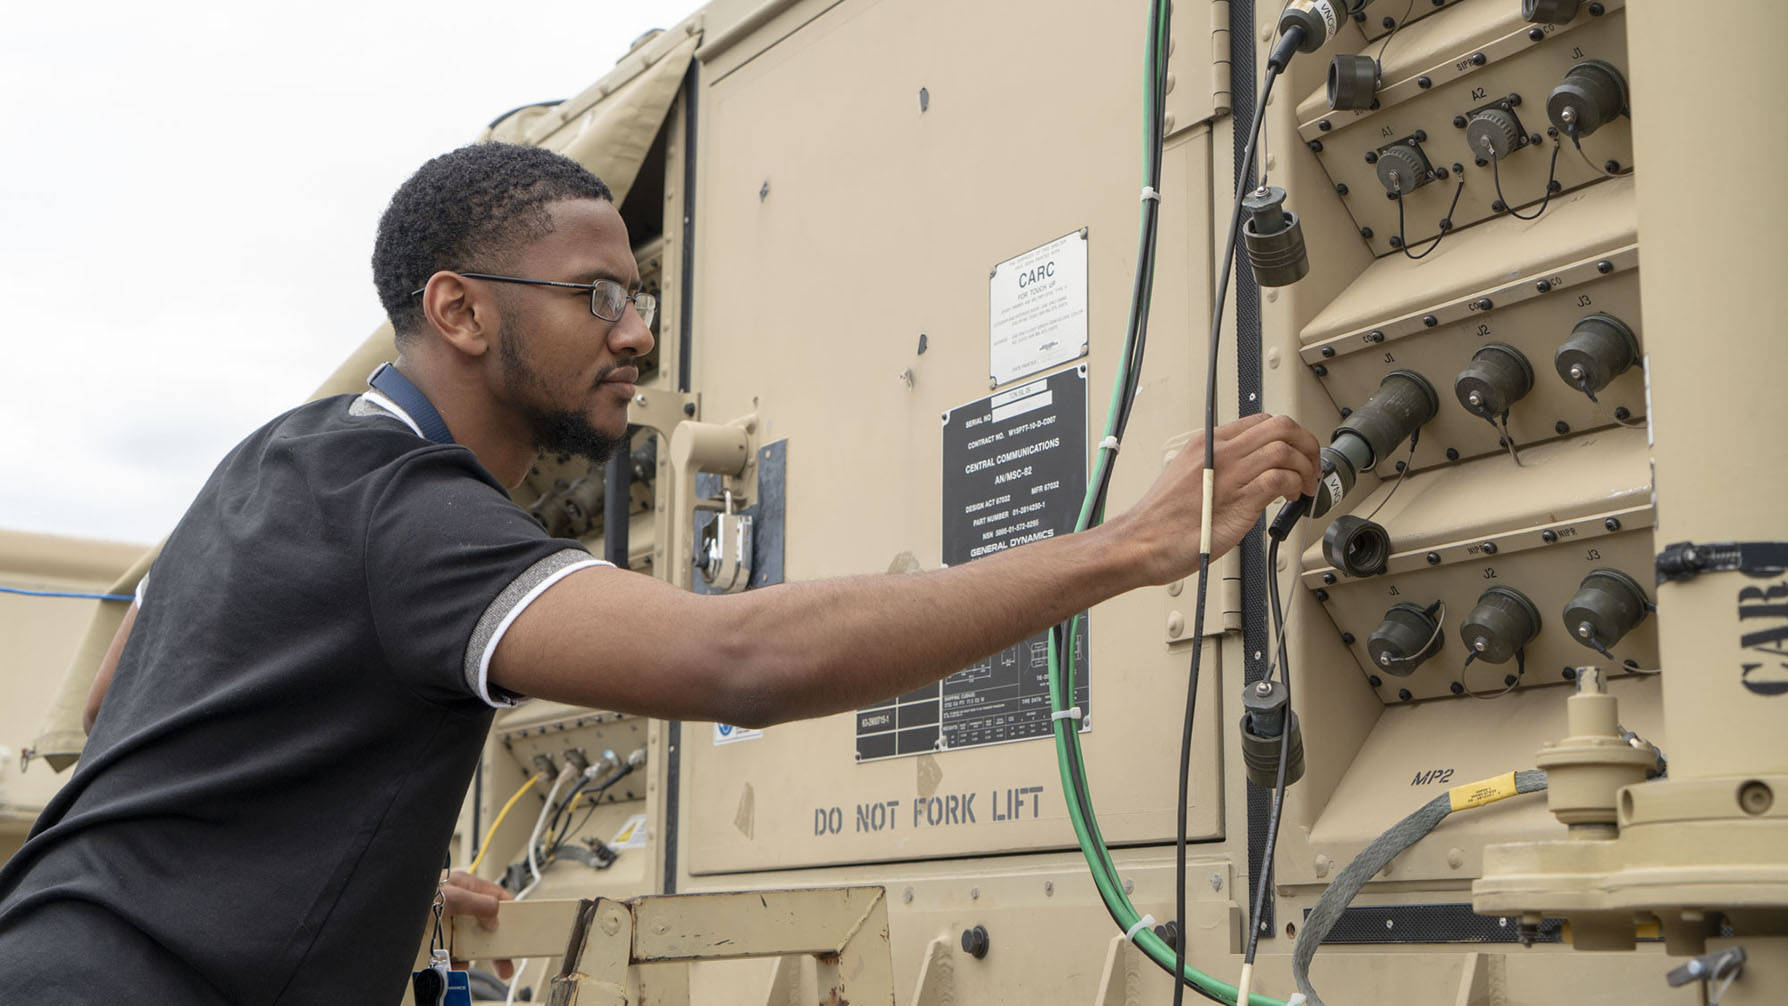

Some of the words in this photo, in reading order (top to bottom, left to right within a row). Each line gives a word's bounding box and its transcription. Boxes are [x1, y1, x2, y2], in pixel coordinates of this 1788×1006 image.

[1571, 46, 1584, 60] J1
[1471, 87, 1487, 101] A2
[1381, 126, 1394, 139] A1
[1018, 261, 1055, 288] CARC
[1577, 294, 1592, 308] J3
[1477, 324, 1491, 337] J2
[1384, 352, 1396, 364] J1
[965, 416, 983, 429] SERIAL
[967, 435, 995, 450] CONTRACT
[965, 457, 996, 474] CENTRAL
[996, 437, 1060, 464] COMMUNICATIONS
[973, 515, 987, 527] PART
[987, 510, 1009, 523] NUMBER
[970, 541, 1008, 558] GENERAL
[1009, 529, 1055, 548] DYNAMICS
[1586, 548, 1601, 561] J3
[1483, 567, 1497, 579] J2
[1389, 585, 1400, 596] J1
[1738, 566, 1788, 697] CAR
[1410, 768, 1455, 786] MP2
[814, 807, 843, 837] DO
[856, 800, 900, 832] NOT
[913, 793, 977, 828] FORK
[992, 785, 1044, 822] LIFT
